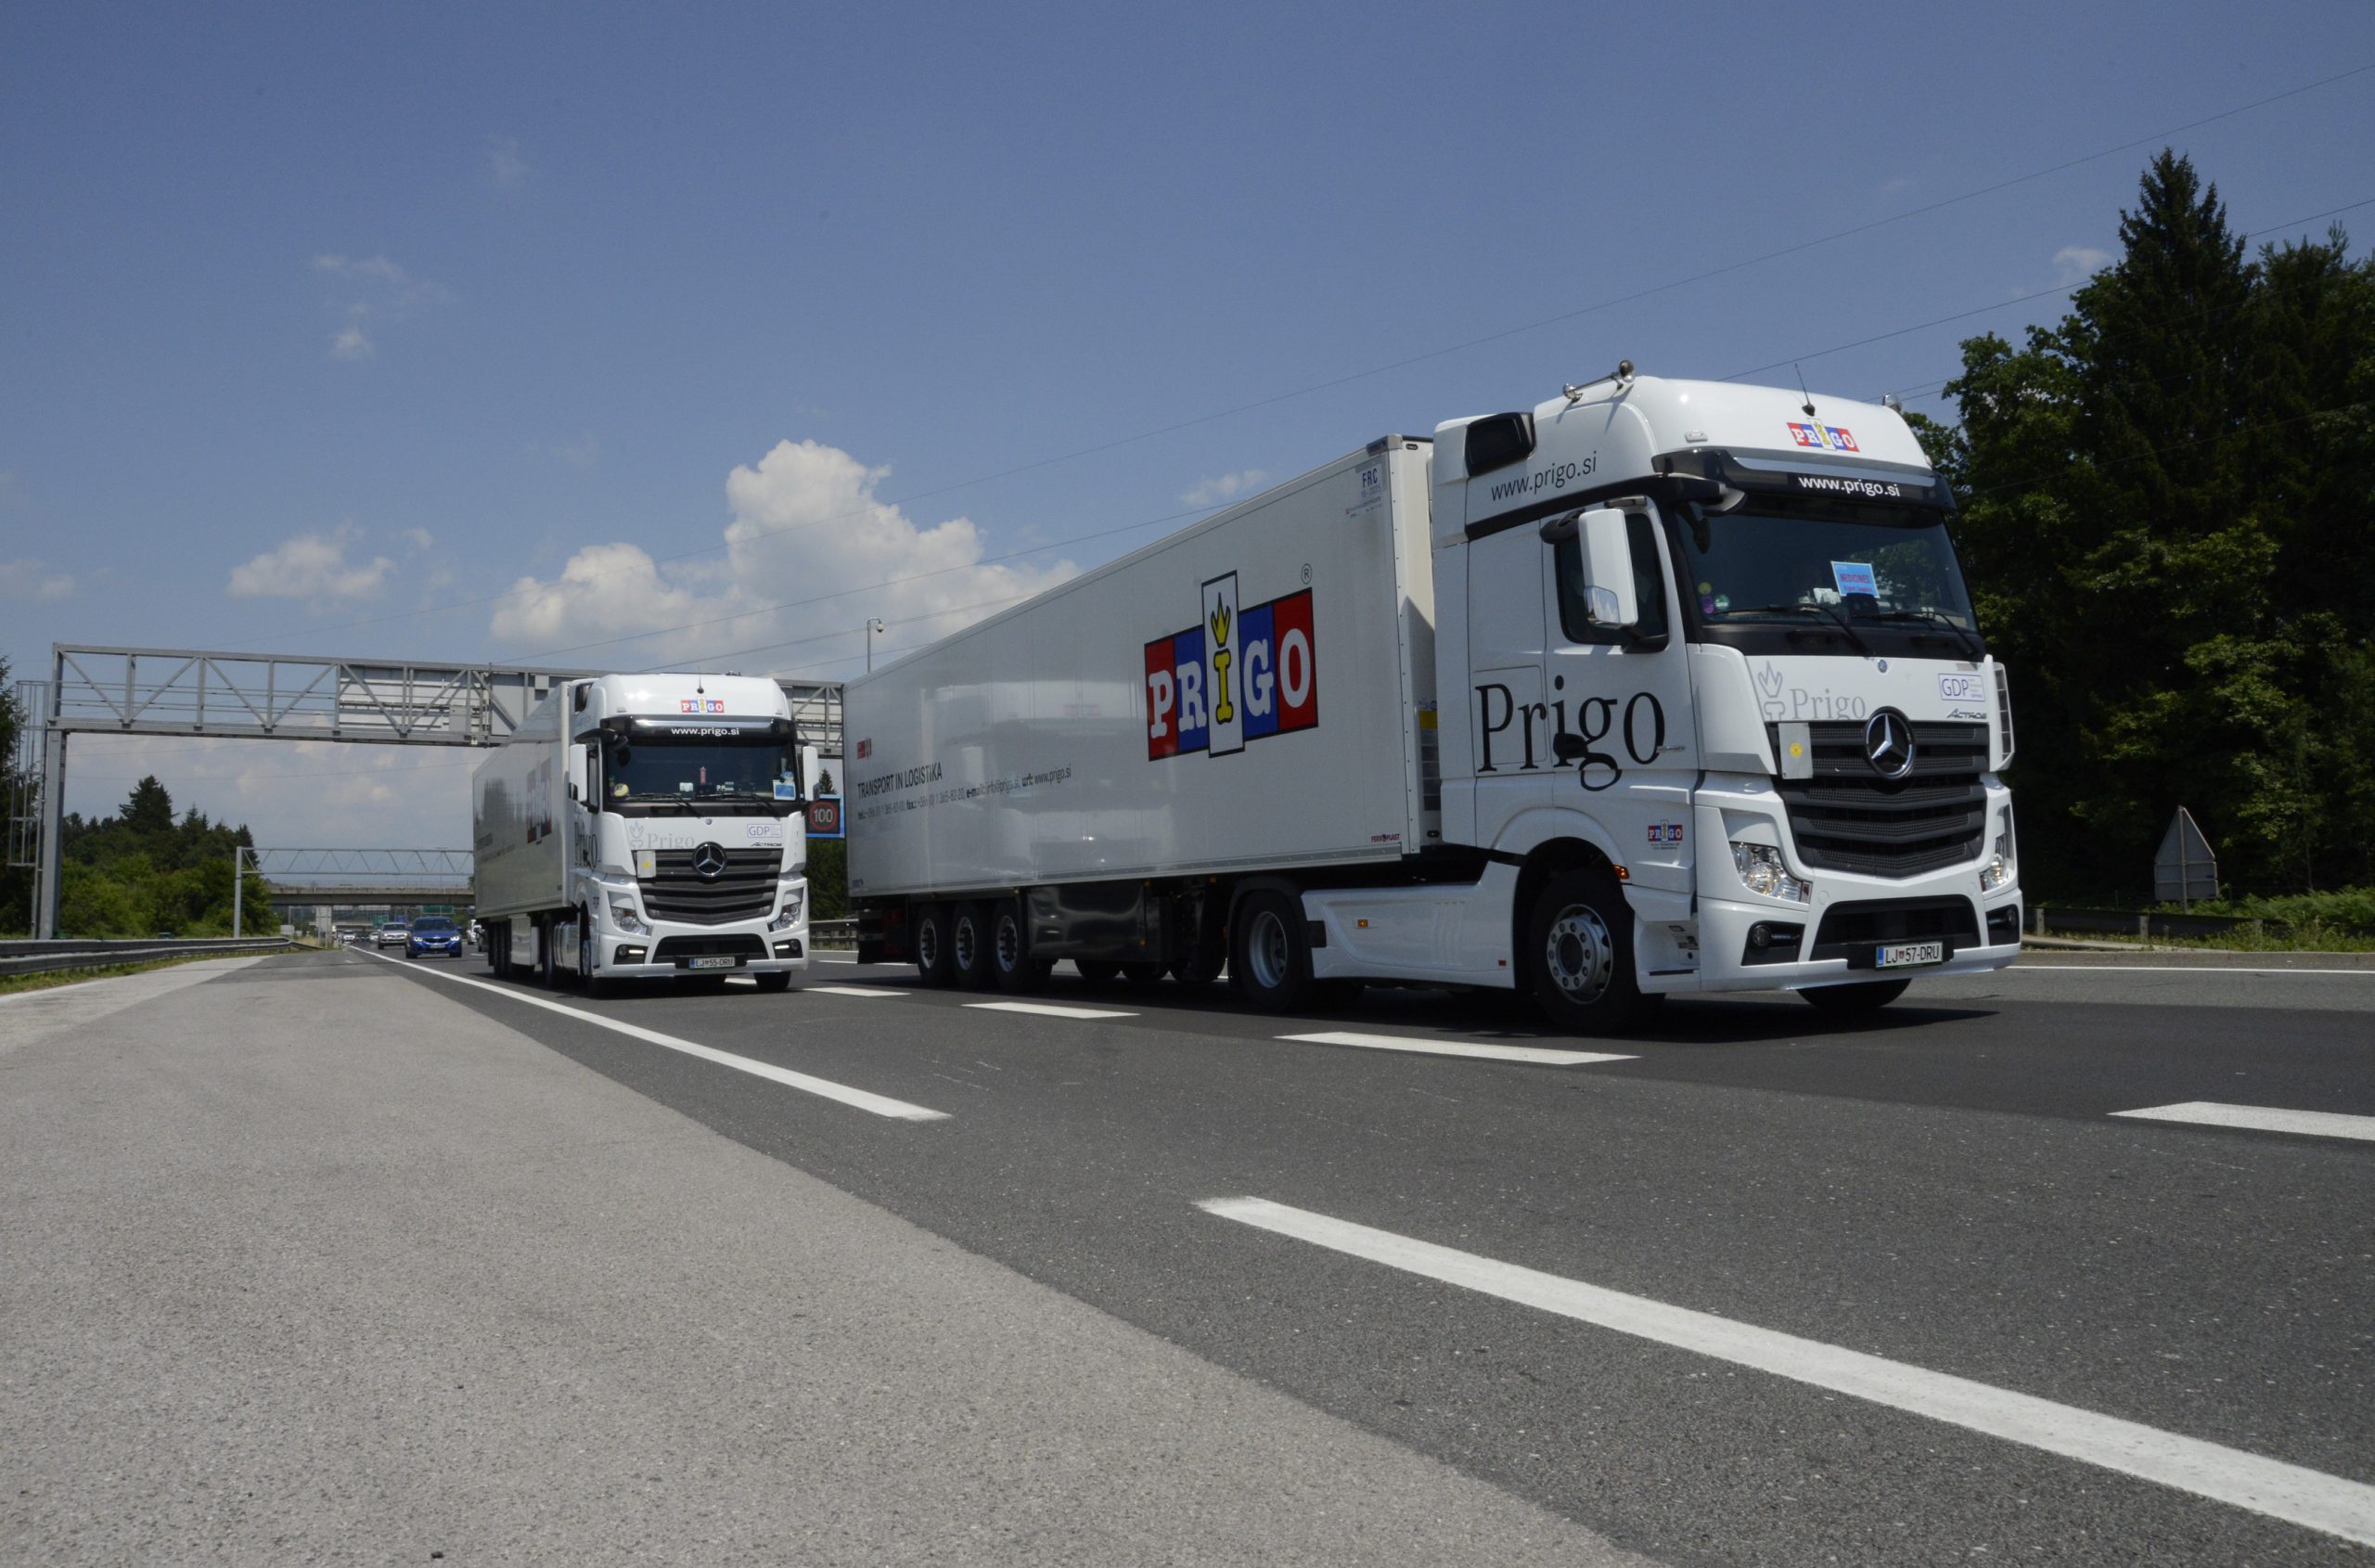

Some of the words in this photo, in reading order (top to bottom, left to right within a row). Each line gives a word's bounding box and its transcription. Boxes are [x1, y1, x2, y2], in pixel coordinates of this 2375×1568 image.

[1791, 425, 1856, 448] PRIGO
[1362, 468, 1379, 488] FRC
[1491, 450, 1597, 501] www.prigo.si
[1798, 476, 1902, 497] www.prigo.si
[1149, 627, 1311, 739] PRIGO
[1942, 678, 1969, 697] GDP
[682, 700, 724, 712] PRIGO
[1789, 688, 1867, 720] Prigo
[671, 726, 739, 737] www.prigo.si
[1474, 675, 1666, 792] Prigo
[857, 774, 893, 800] TRANSPORT
[895, 773, 903, 790] IN
[905, 762, 943, 788] LOGISTIKA
[1034, 763, 1072, 784] www.prigo.si
[814, 809, 833, 822] 100
[648, 833, 694, 849] Prigo
[749, 827, 770, 836] GDP
[1885, 948, 1898, 964] LJ
